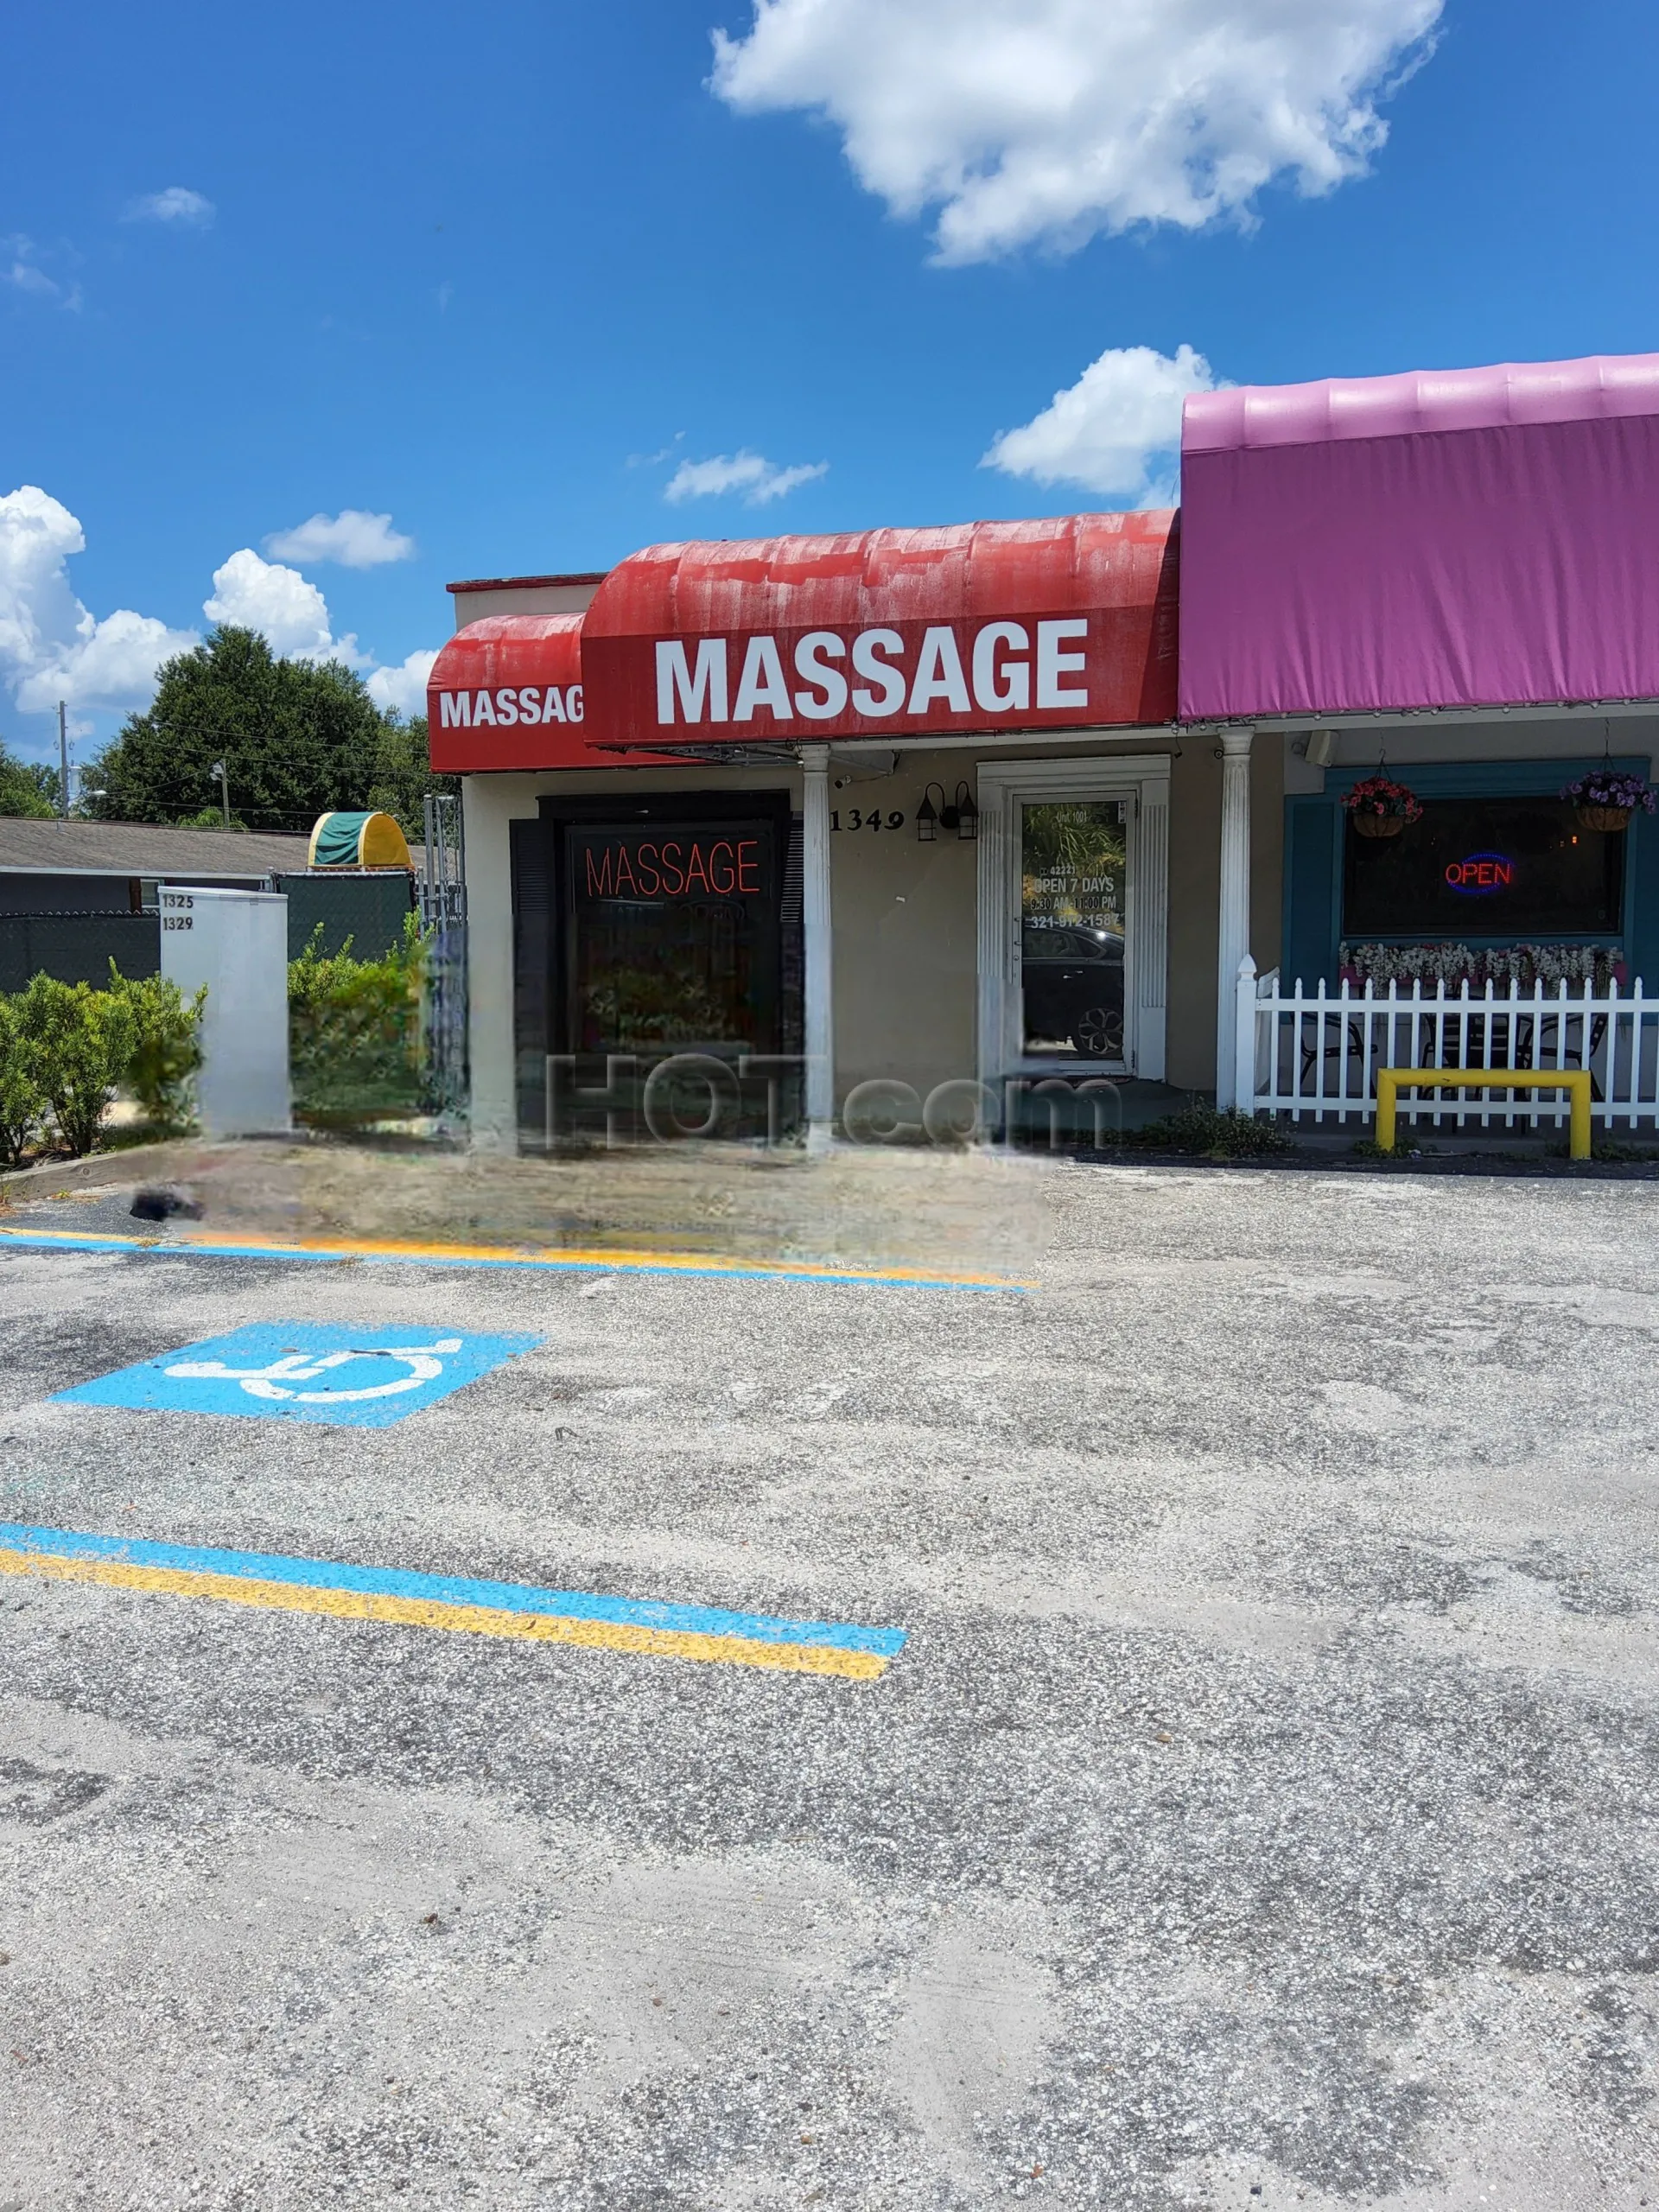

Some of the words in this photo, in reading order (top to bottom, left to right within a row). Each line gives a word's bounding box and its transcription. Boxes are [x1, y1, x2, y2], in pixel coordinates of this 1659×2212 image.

[656, 619, 1088, 724] MASSAGE
[830, 809, 904, 831] 1349
[586, 841, 760, 896] MASSAGE
[1446, 863, 1511, 883] OPEN
[1034, 878, 1066, 893] OPEN
[1071, 878, 1078, 893] 7
[1082, 877, 1115, 892] DAYS
[162, 893, 194, 908] 1325
[1102, 895, 1116, 909] PM
[162, 917, 194, 931] 1329
